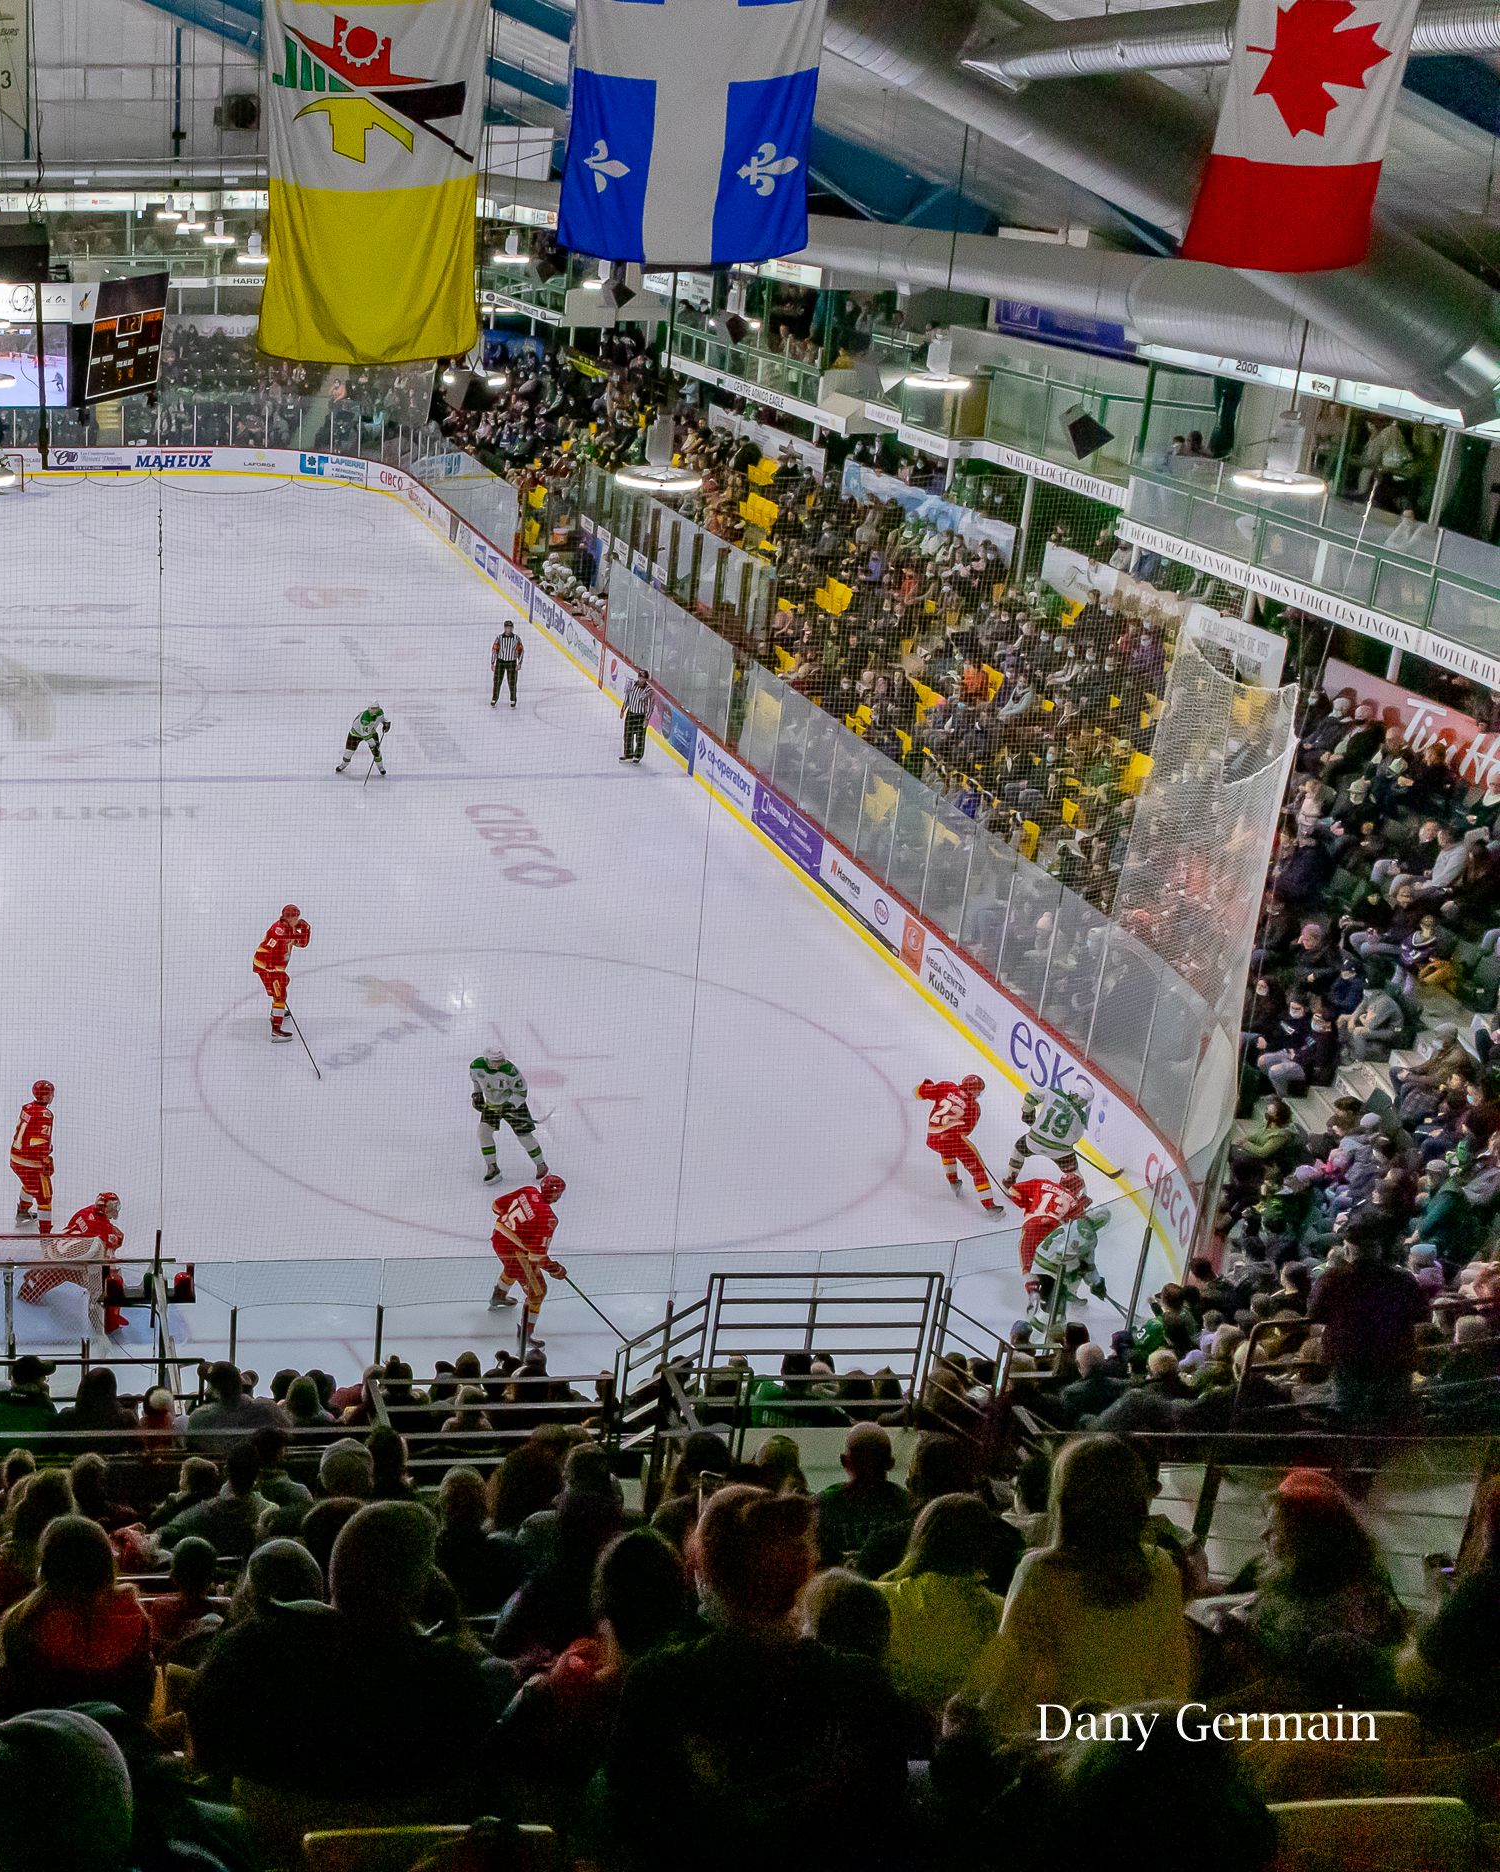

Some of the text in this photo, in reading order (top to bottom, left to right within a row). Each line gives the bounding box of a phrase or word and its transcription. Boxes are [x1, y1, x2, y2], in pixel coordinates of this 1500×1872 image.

[134, 455, 214, 468] MAHEUX
[1006, 453, 1040, 476] SERVICE
[1070, 474, 1113, 501] COMPLET
[1130, 521, 1184, 561] DÉCOUVREZ
[1201, 549, 1270, 590] INNOVATIONS
[1269, 577, 1291, 598] DES
[1290, 584, 1357, 625] VÉHICULES
[1356, 606, 1413, 646] LINCOLN
[1430, 640, 1480, 677] MOTEUR
[707, 748, 752, 797] co-operators
[925, 953, 967, 998] MEGA CENTRE
[928, 970, 960, 1010] Kubota
[1009, 1020, 1093, 1100] esk
[929, 1099, 966, 1126] 22
[1039, 1106, 1074, 1139] 19
